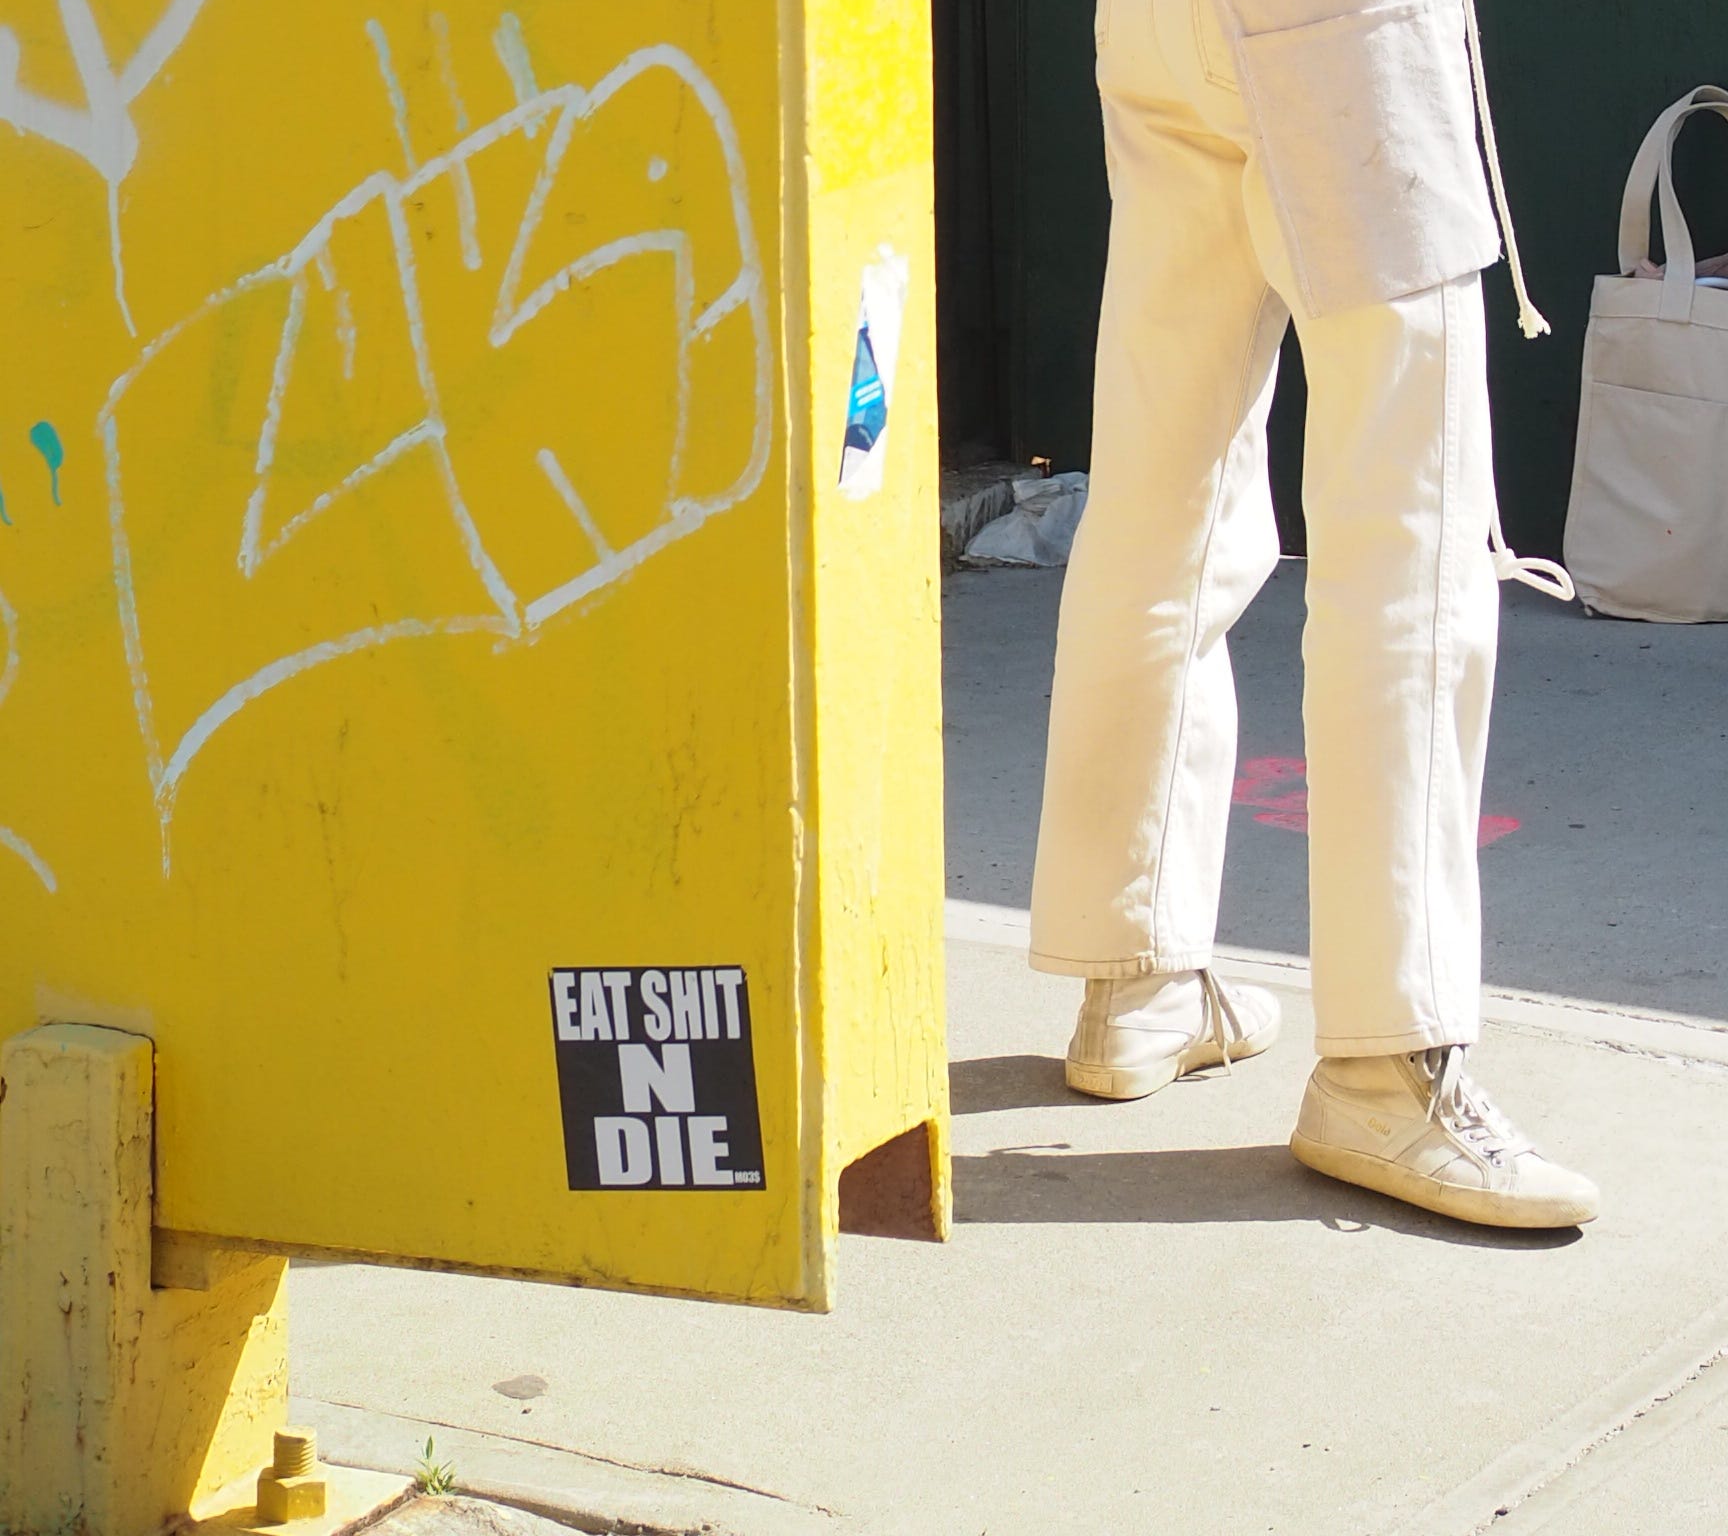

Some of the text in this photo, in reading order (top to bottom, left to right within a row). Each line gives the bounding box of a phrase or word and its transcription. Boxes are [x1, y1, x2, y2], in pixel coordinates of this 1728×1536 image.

[552, 969, 743, 1042] EAT SHIT
[617, 1042, 696, 1114] N
[593, 1114, 735, 1186] DIE
